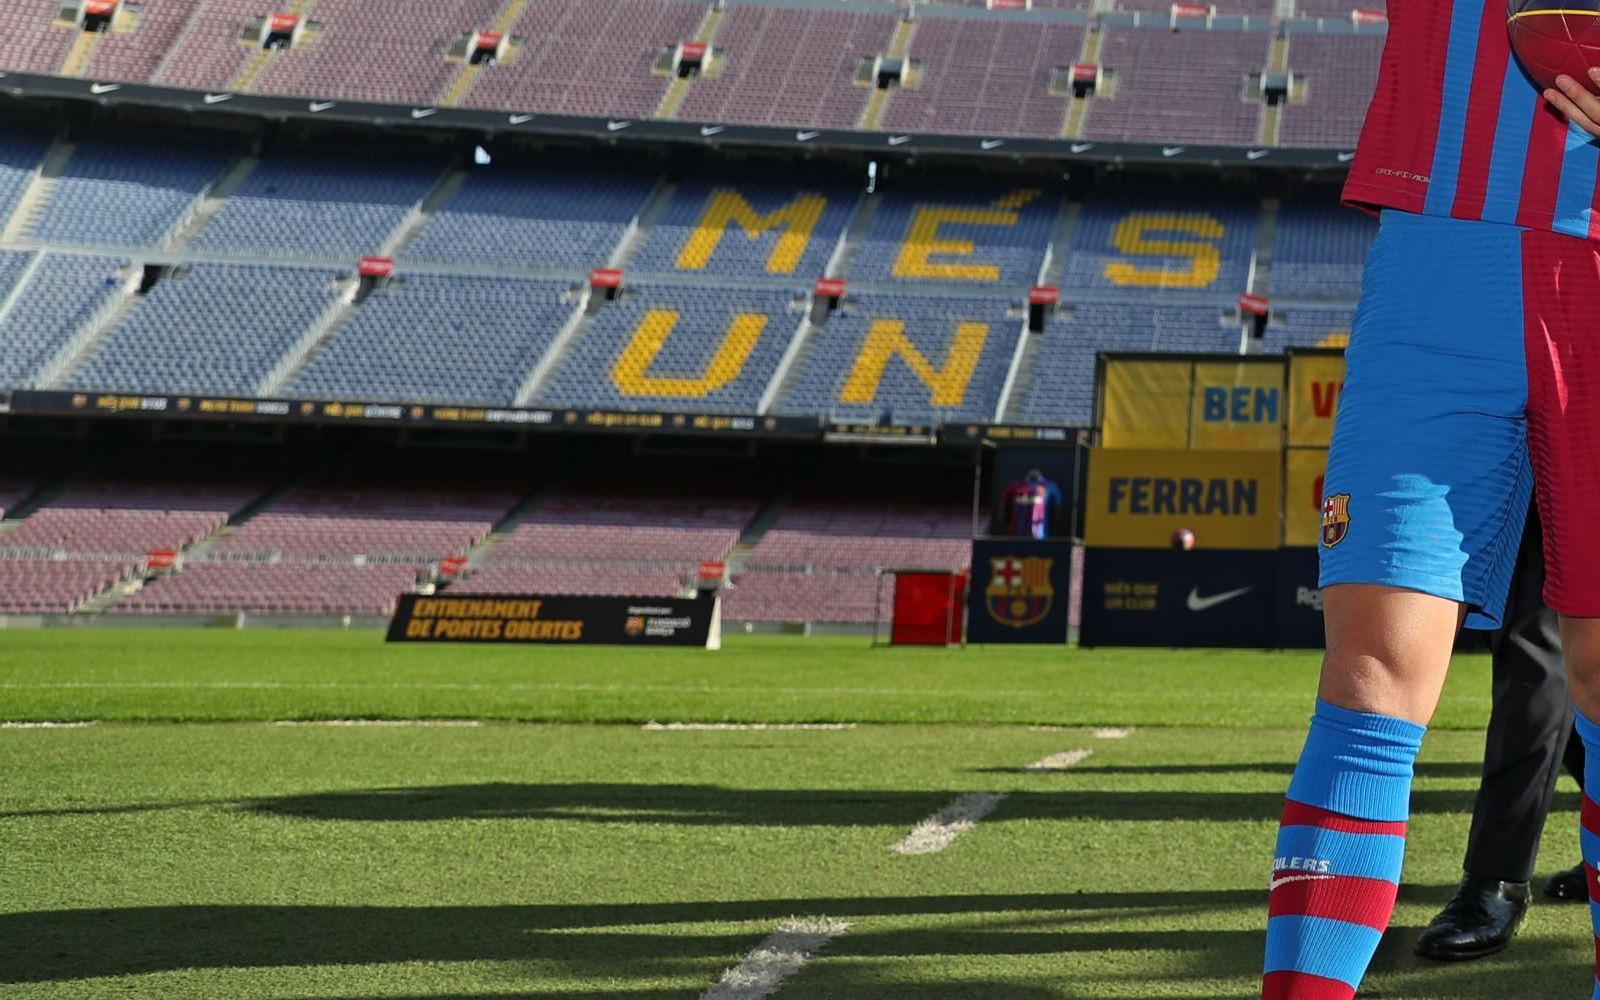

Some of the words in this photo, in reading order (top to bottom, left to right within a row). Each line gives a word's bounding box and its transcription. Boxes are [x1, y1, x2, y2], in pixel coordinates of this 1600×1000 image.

[675, 188, 1225, 288] MÉS
[610, 310, 991, 407] UN
[1203, 387, 1279, 423] BEN
[1108, 477, 1258, 515] FERRAN
[412, 600, 543, 619] ENTRENAMENT
[406, 618, 433, 638] DE
[434, 618, 502, 639] PORTES
[504, 620, 584, 640] OBERTES
